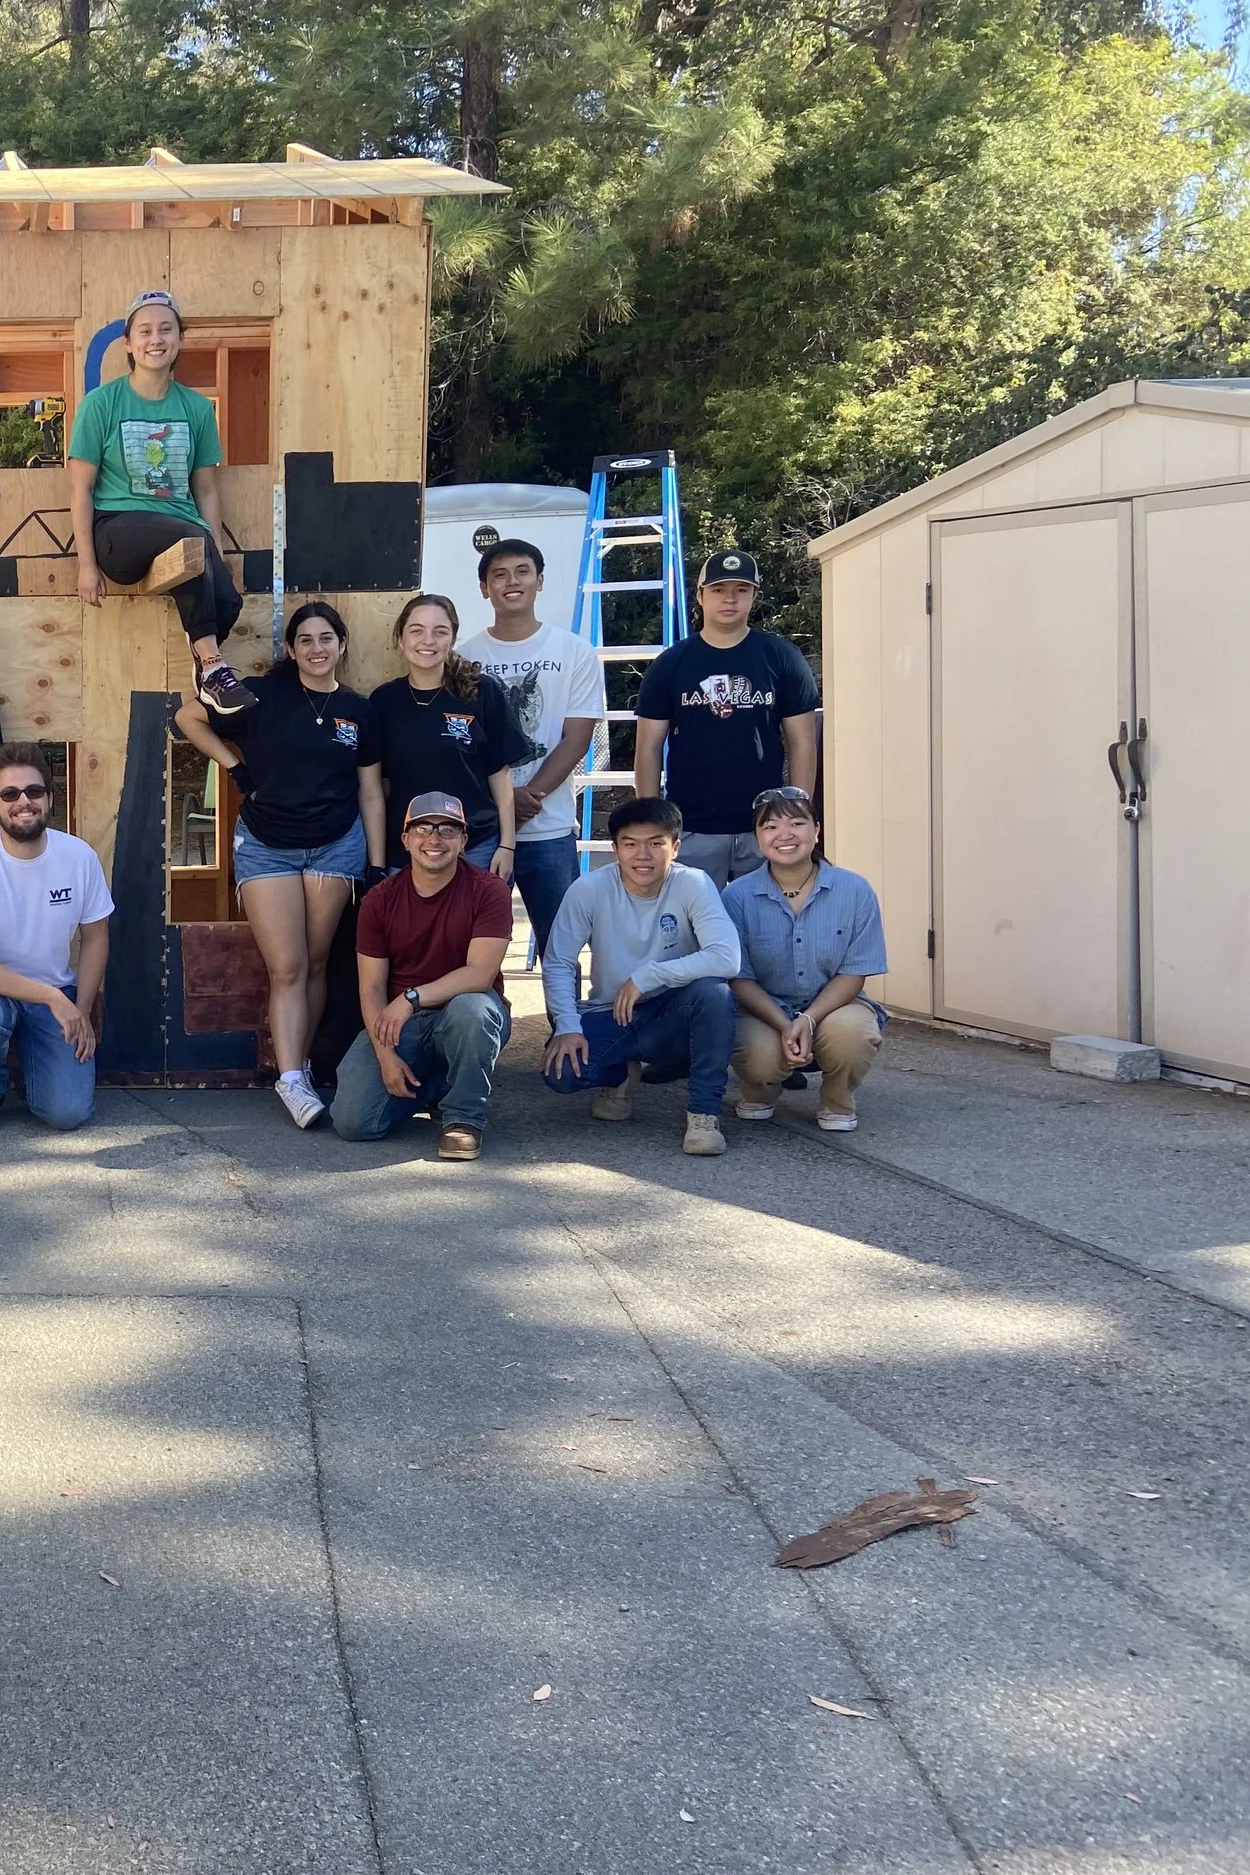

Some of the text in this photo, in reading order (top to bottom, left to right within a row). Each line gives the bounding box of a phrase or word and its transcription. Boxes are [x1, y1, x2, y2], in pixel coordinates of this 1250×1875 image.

[483, 660, 562, 675] EEP TOKEN
[681, 690, 773, 706] LAS VEGAS
[50, 888, 72, 899] WT
